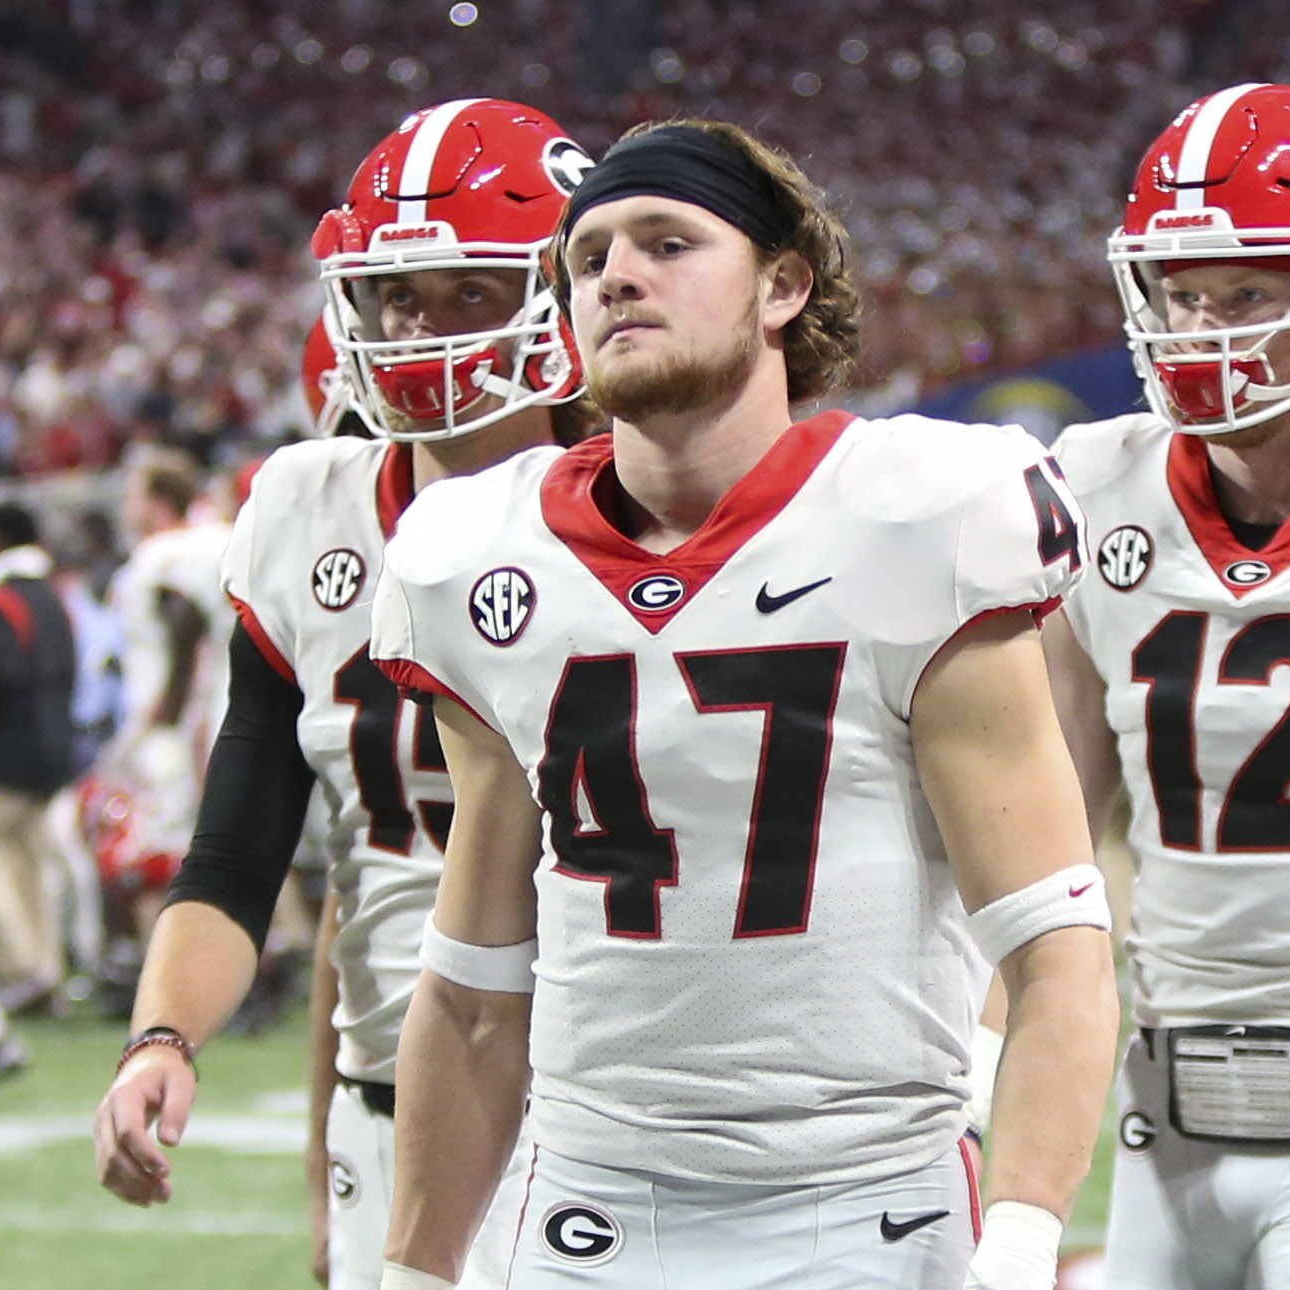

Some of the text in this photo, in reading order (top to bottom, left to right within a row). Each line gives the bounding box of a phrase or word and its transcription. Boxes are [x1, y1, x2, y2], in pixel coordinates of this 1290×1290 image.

[313, 549, 363, 609] SEC
[1099, 527, 1151, 589] SEC
[1225, 560, 1272, 584] G
[472, 568, 533, 643] SEC
[629, 576, 685, 611] G
[538, 640, 849, 941] 47
[543, 1205, 620, 1260] G
